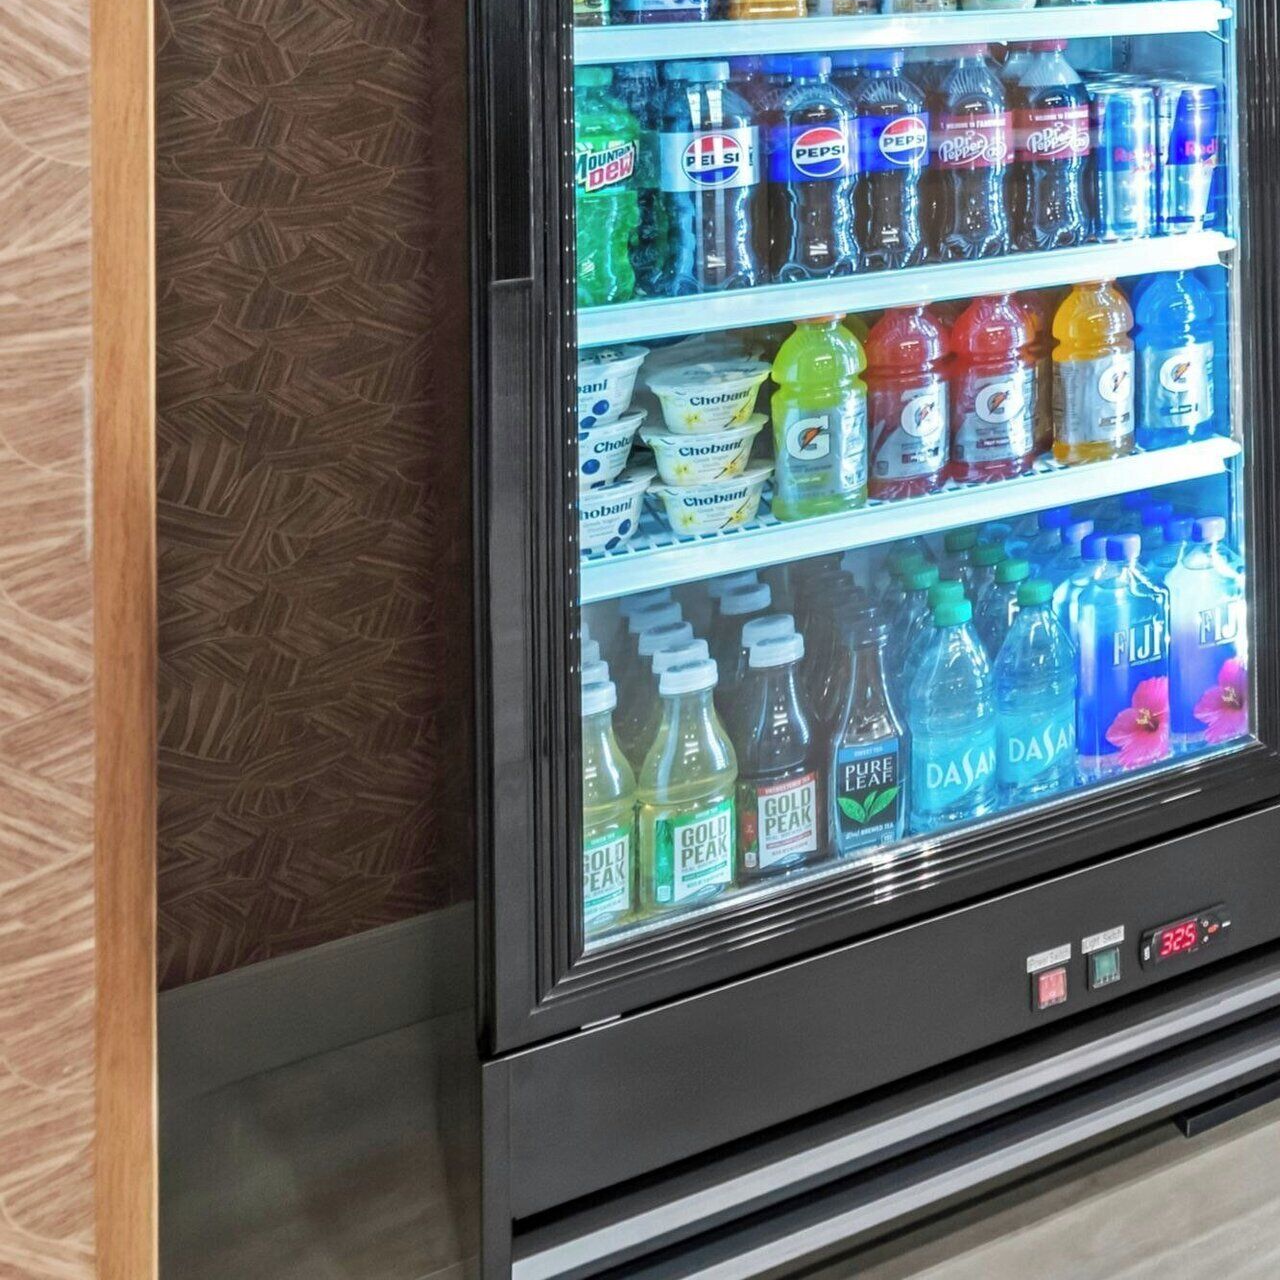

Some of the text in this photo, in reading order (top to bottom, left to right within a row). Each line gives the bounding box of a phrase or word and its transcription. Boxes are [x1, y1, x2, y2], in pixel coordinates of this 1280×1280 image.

[795, 144, 846, 159] PEPSI
[883, 134, 926, 148] PEPSI
[690, 387, 752, 407] Chobani
[679, 439, 744, 457] Chobani
[684, 487, 749, 507] Chobani
[1113, 616, 1166, 666] FIJI
[1008, 723, 1075, 767] DASAN
[845, 756, 893, 779] PURE
[926, 743, 997, 790] DASAN
[845, 771, 892, 792] LEAF
[764, 787, 811, 817] GOLD
[681, 816, 727, 847] GOLD
[765, 807, 811, 836] PEAK
[681, 839, 728, 868] PEAK
